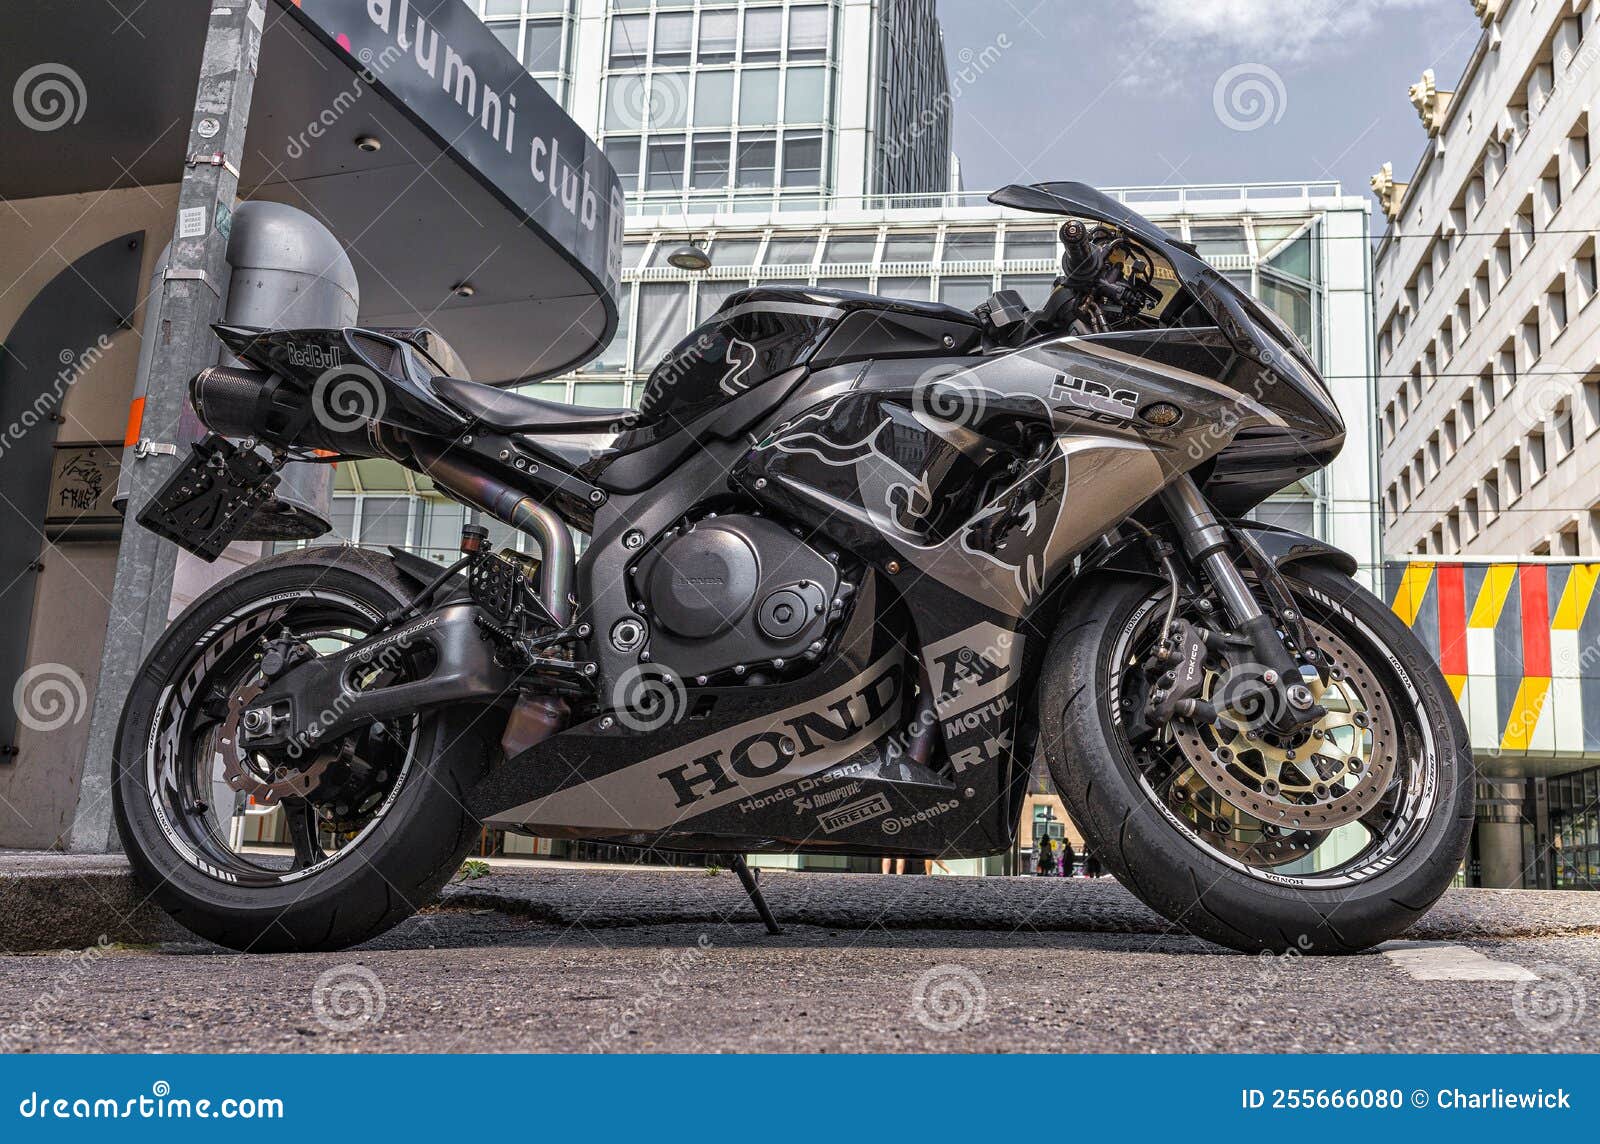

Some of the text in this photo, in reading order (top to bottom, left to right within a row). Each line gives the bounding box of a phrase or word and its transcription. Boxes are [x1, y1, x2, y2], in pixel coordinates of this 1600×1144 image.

[367, 0, 597, 231] alumni club
[1049, 372, 1139, 419] HRC
[1124, 608, 1147, 635] HONDA
[1186, 643, 1199, 681] TOKICO
[1389, 655, 1412, 689] HONDA
[945, 695, 1014, 739] MOTUL
[950, 727, 1014, 773] RK
[738, 762, 863, 815] Honda Dream
[156, 806, 173, 837] HONDA
[819, 795, 890, 832] PIRELLI
[900, 799, 960, 828] brembo
[1264, 872, 1304, 886] HONDA
